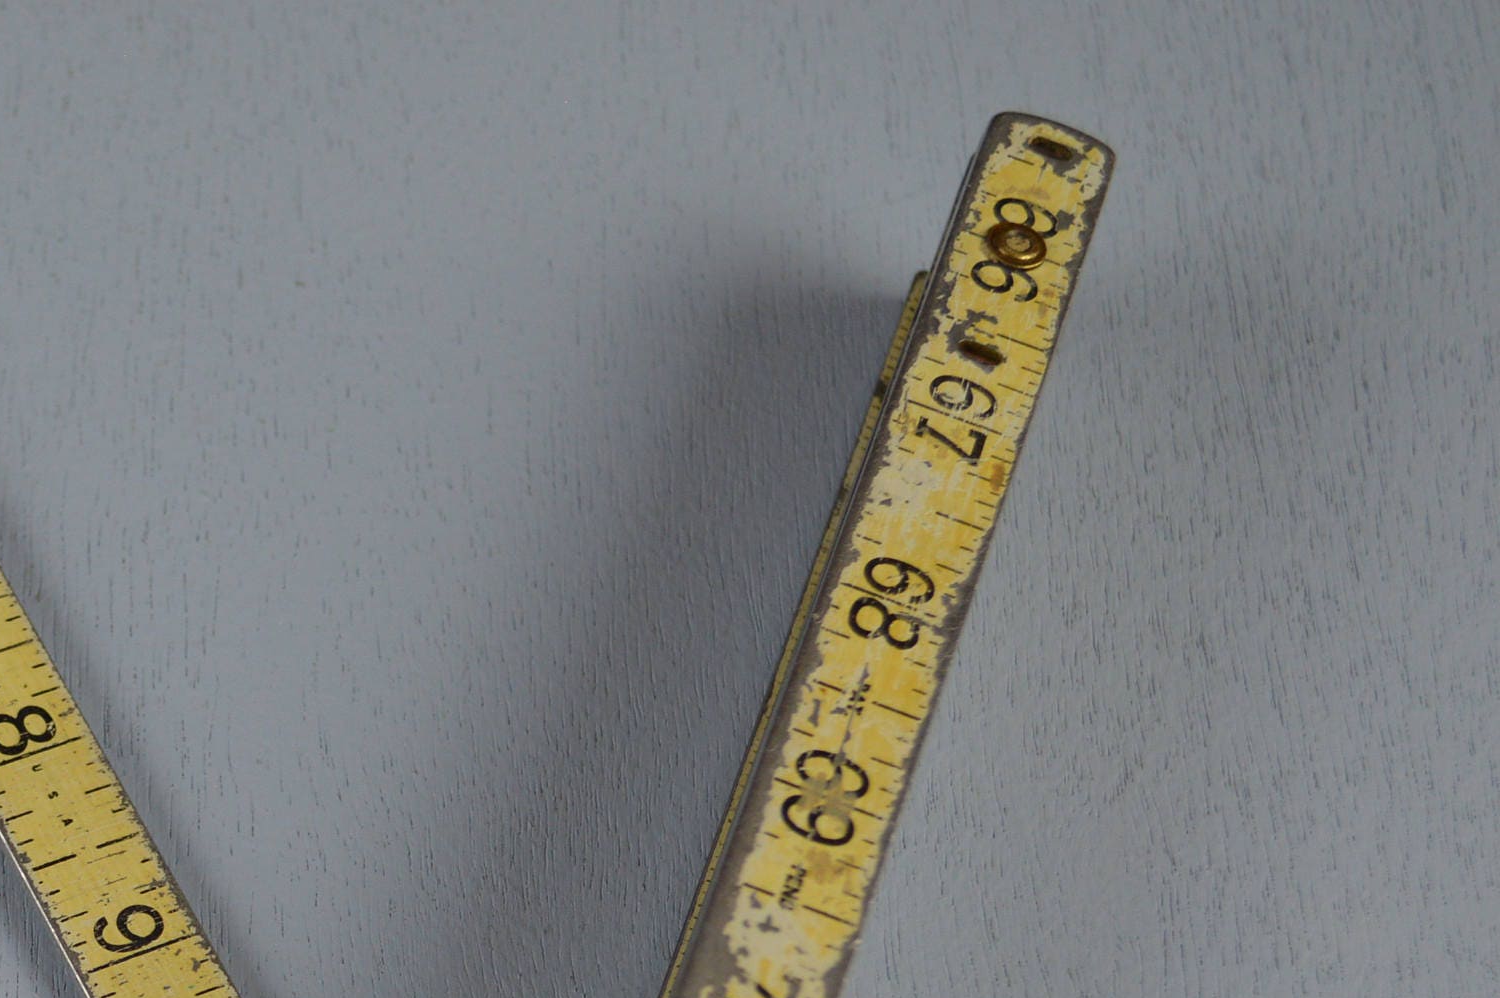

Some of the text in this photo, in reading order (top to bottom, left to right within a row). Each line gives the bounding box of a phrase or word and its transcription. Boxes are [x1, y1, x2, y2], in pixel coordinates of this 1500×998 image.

[969, 197, 1060, 303] 66
[914, 374, 998, 467] 67
[848, 556, 935, 650] 68
[780, 749, 870, 847] 69
[93, 904, 165, 953] 9
